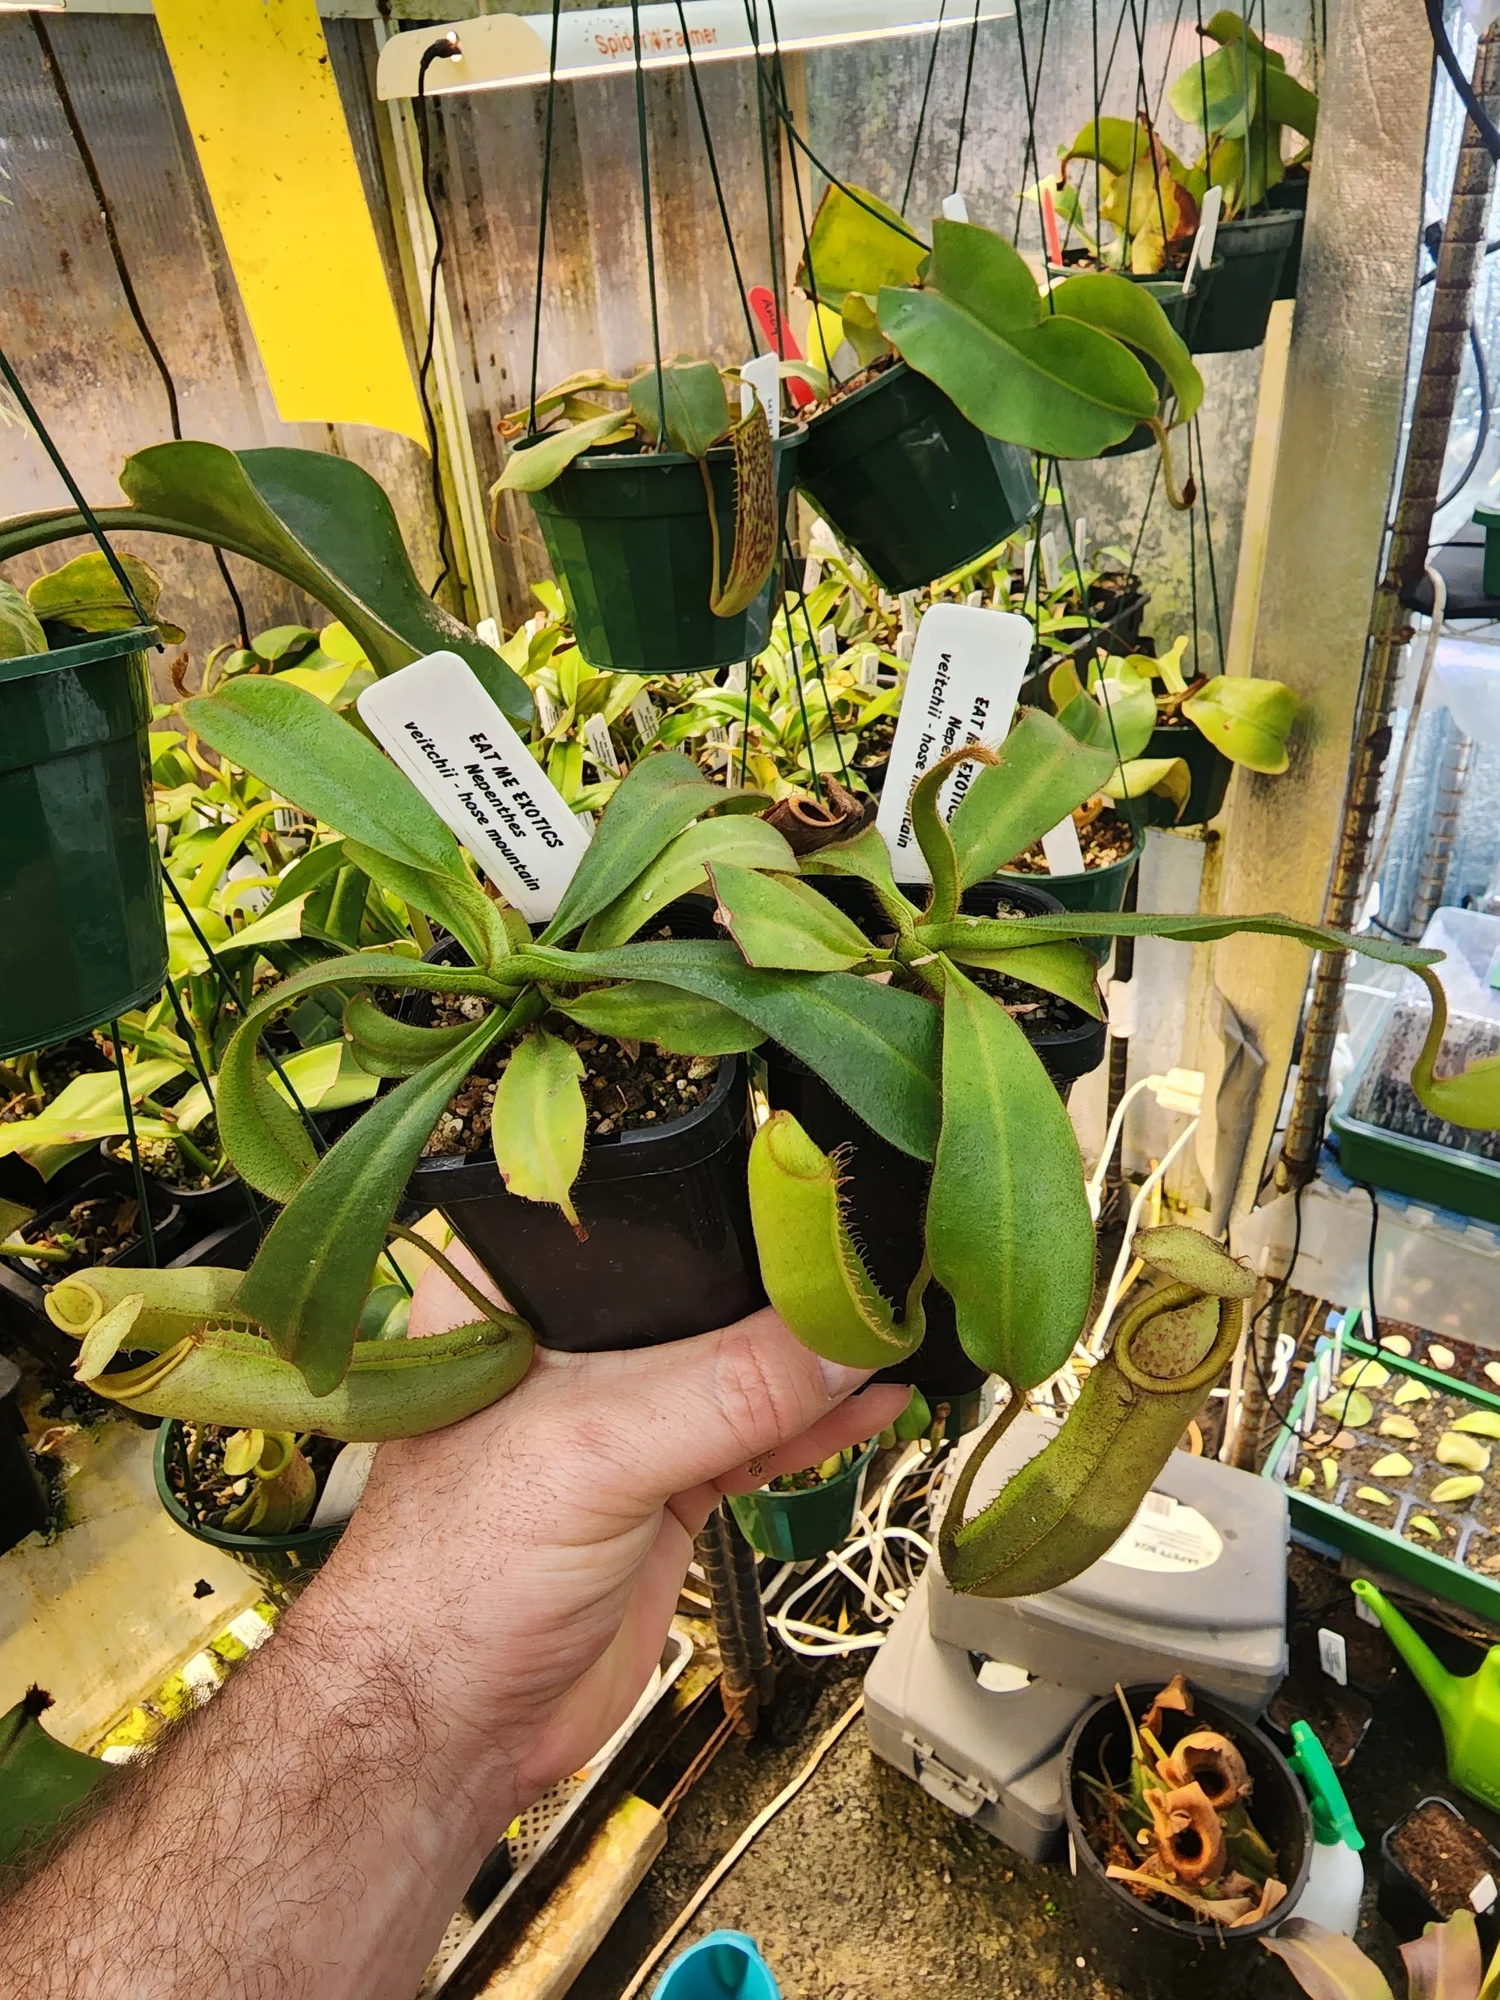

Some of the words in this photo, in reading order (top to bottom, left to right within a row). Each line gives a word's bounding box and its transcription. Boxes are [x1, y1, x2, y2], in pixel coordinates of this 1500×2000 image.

[594, 30, 648, 59] Spidr
[663, 26, 718, 50] Famer
[927, 652, 952, 721] veitchii
[969, 696, 990, 731] EAT
[915, 733, 936, 771] hose
[403, 720, 459, 779] veitchii
[457, 791, 489, 826] hose
[485, 828, 540, 892] mountain
[463, 763, 526, 839] Nepenthes
[468, 732, 502, 762] EAT
[492, 766, 520, 789] ME
[511, 790, 564, 849] EXOTICS
[896, 774, 922, 849] mtain
